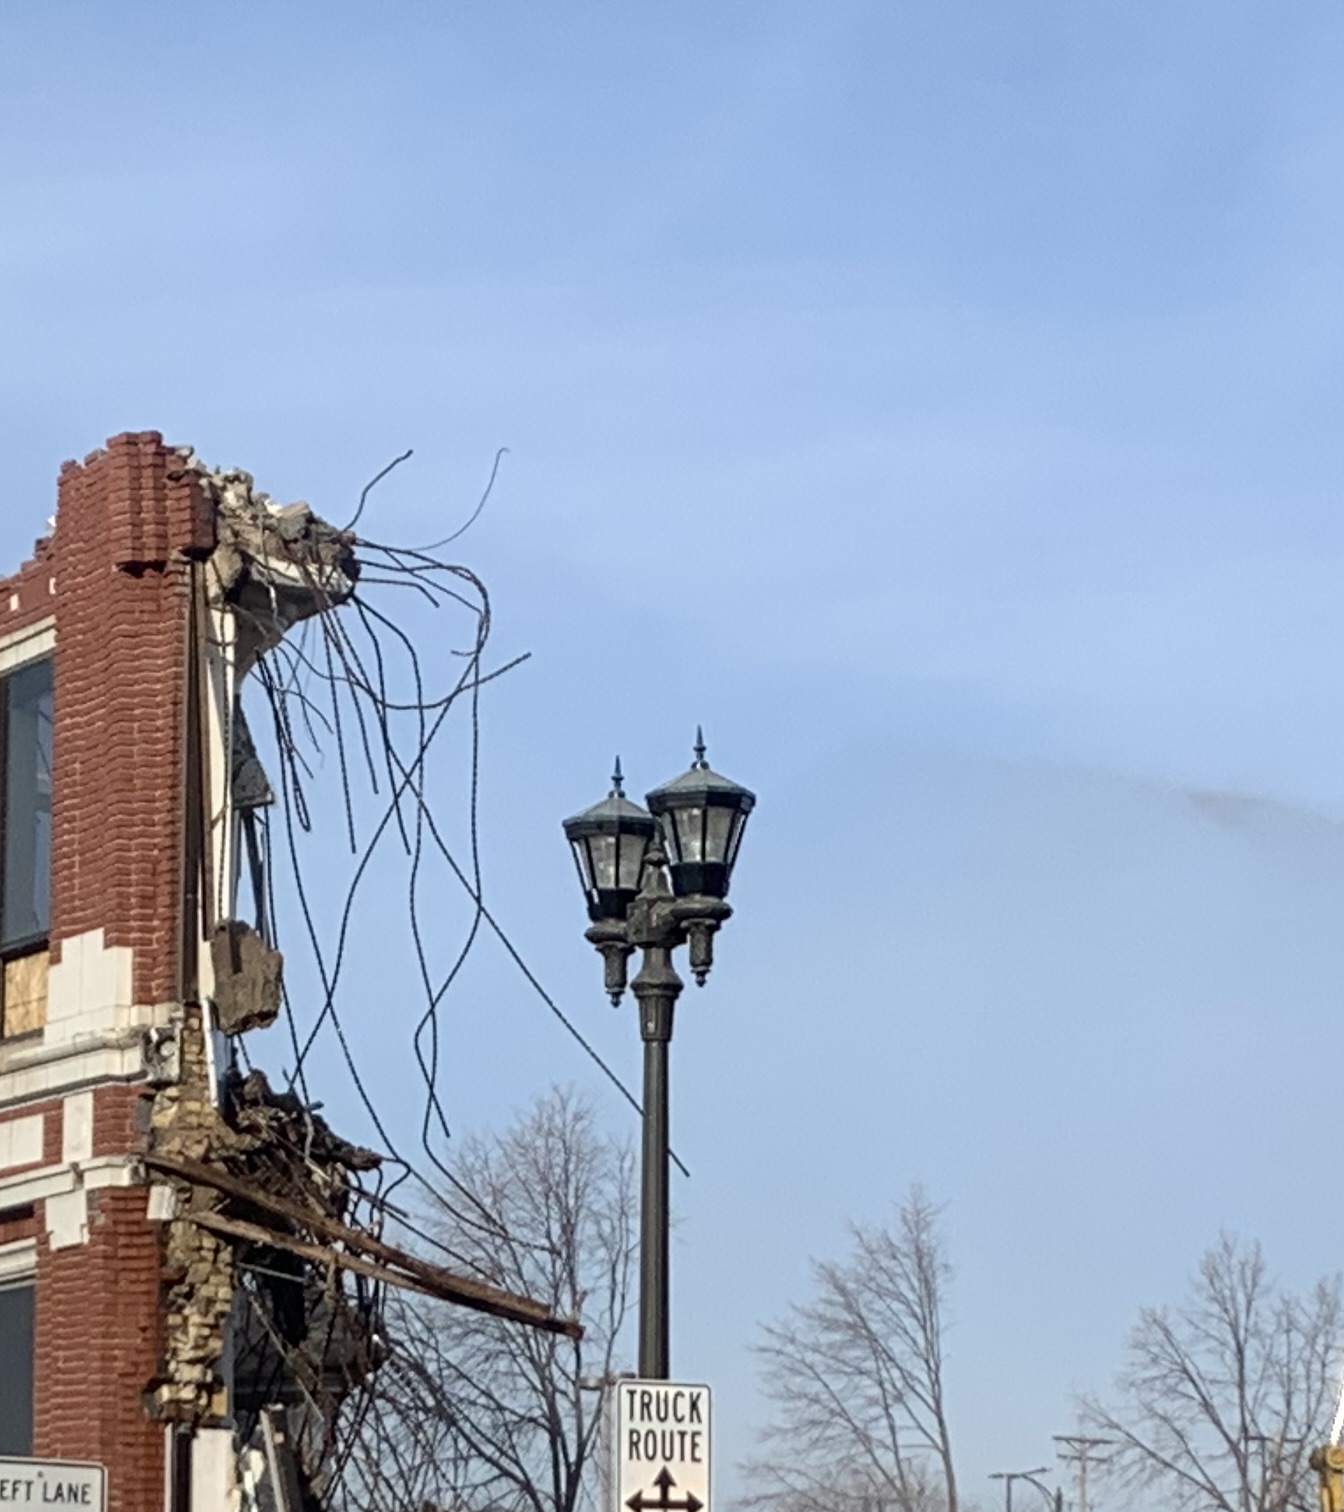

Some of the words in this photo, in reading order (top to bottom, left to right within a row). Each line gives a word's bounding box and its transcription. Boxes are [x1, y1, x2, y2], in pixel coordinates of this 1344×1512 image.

[626, 1388, 703, 1424] TRUCK
[628, 1428, 703, 1463] ROUTE
[42, 1481, 92, 1504] LANE
